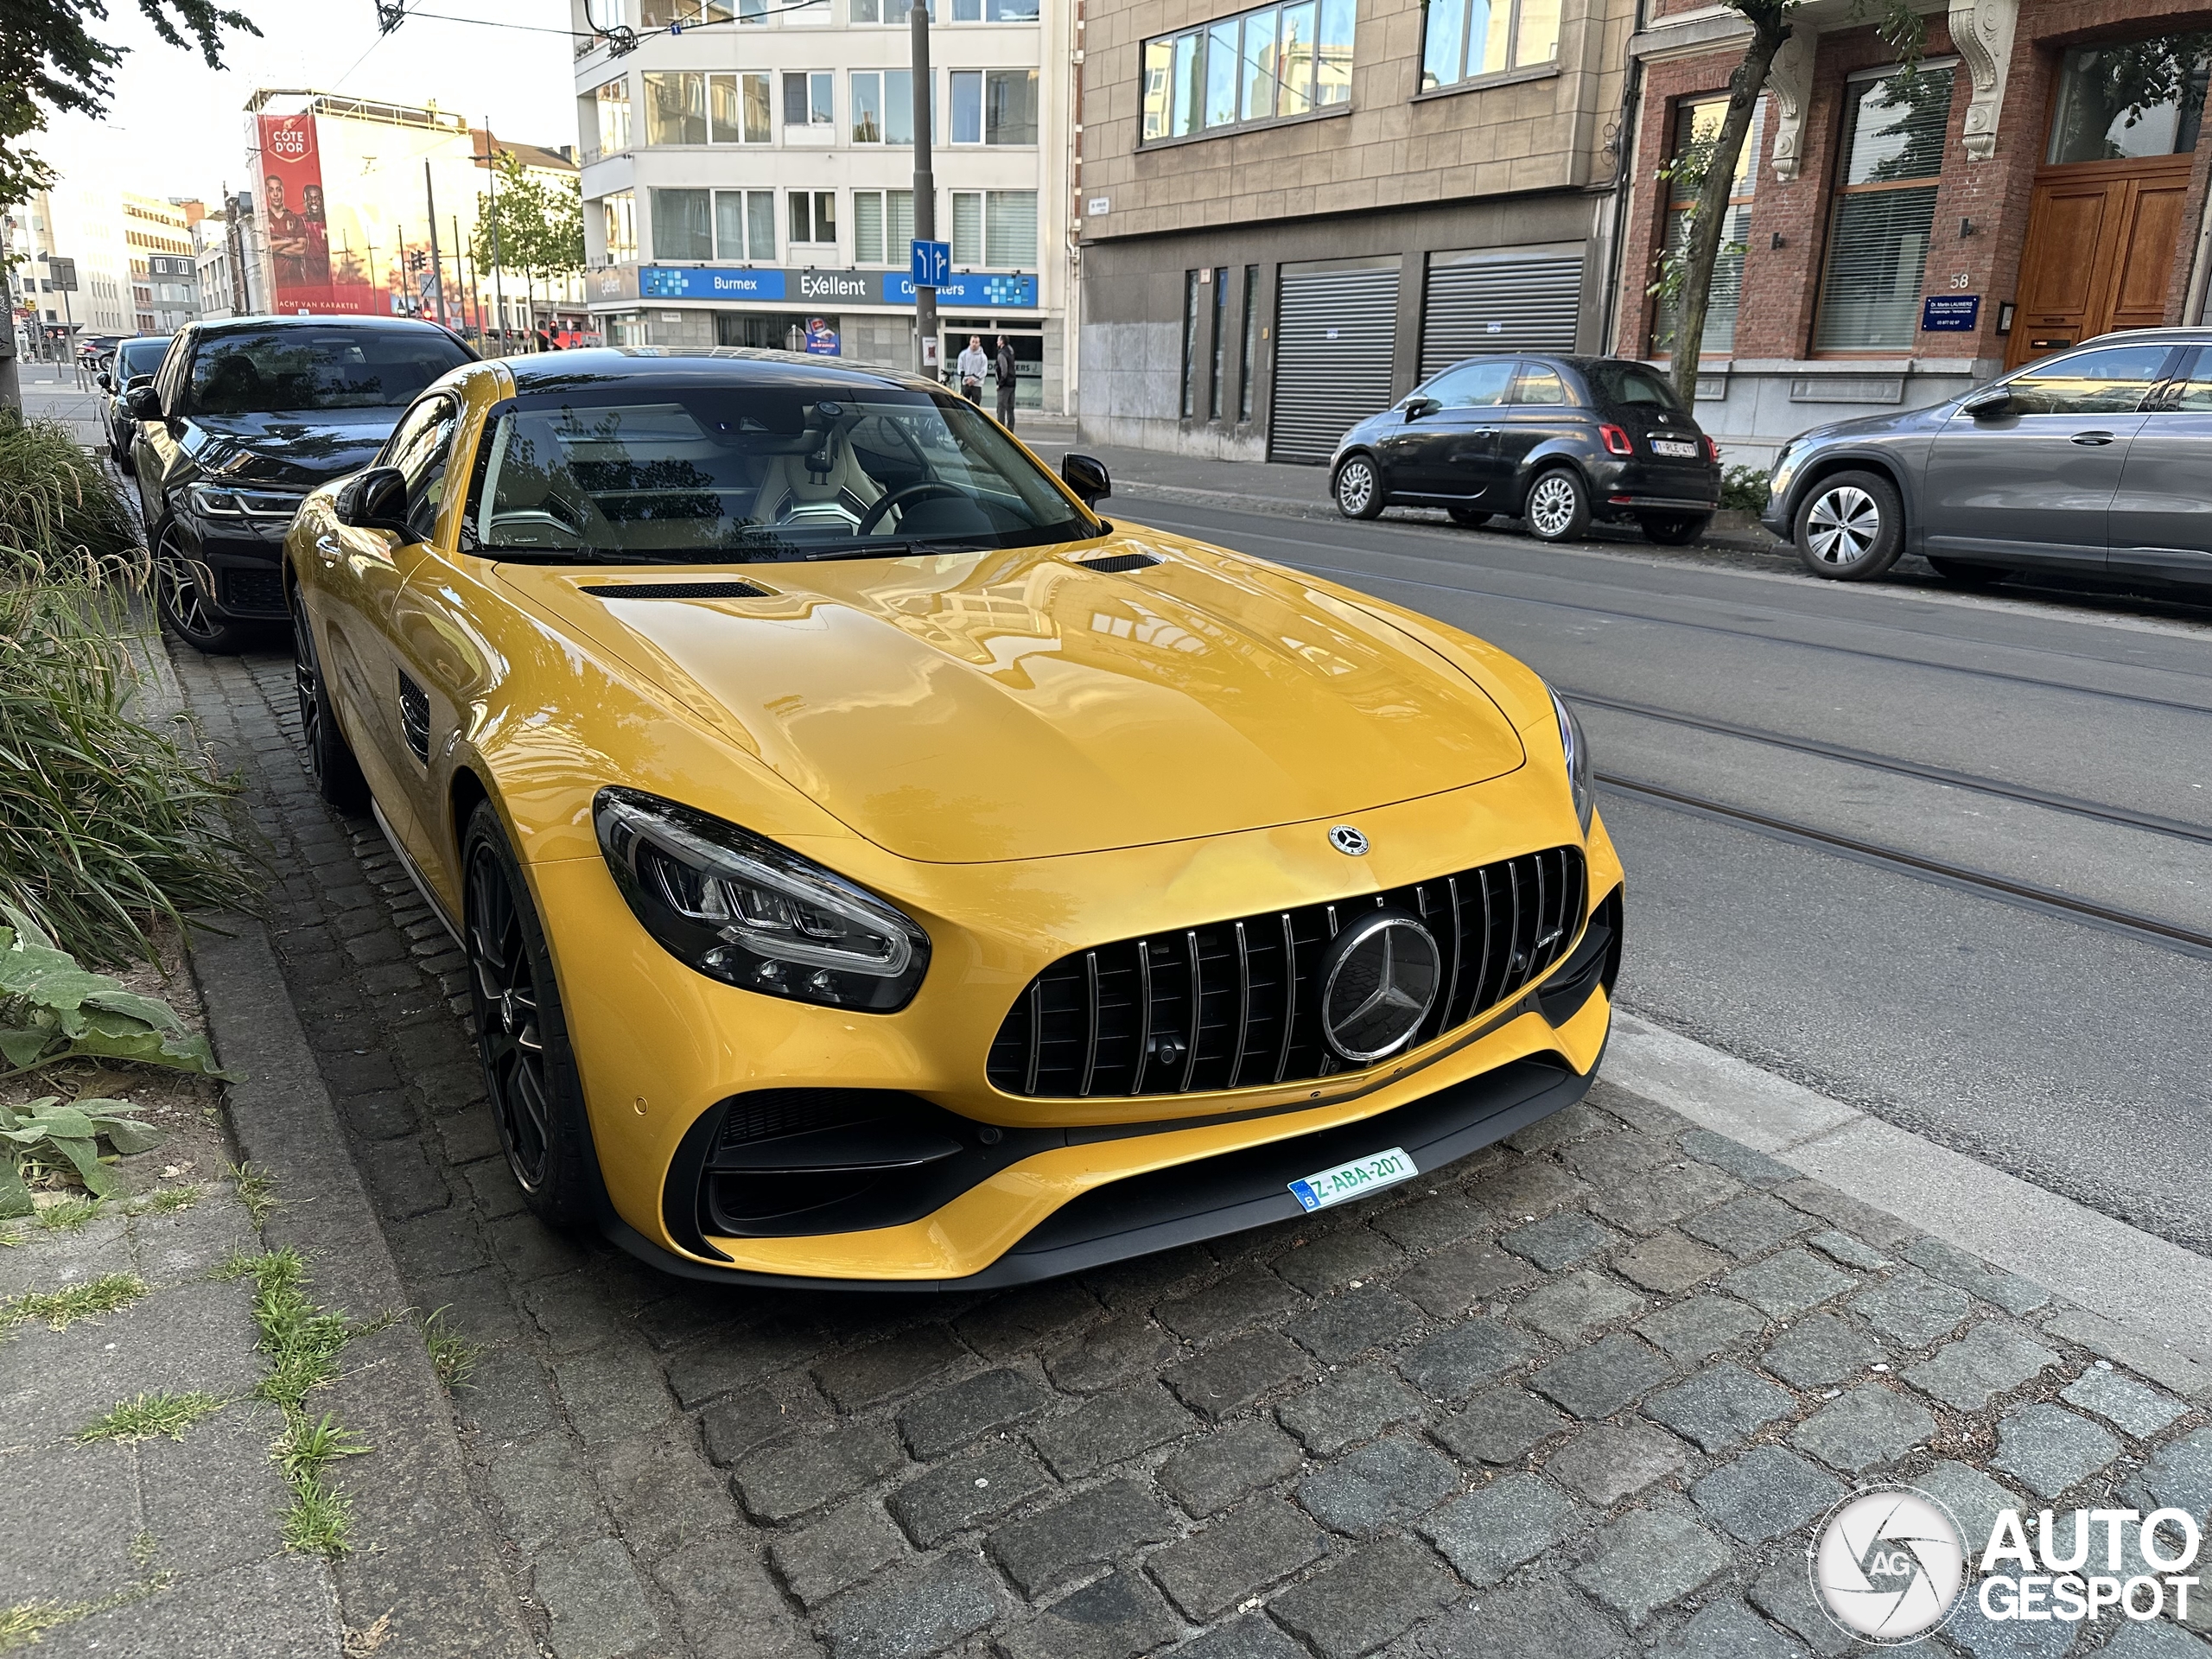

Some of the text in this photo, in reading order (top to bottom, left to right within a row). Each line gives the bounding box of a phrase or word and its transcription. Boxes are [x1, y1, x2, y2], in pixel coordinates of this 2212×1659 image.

[276, 142, 303, 153] D'OR
[714, 276, 757, 290] Burmex
[800, 275, 866, 298] Exellent
[1950, 273, 1969, 289] 58
[320, 301, 359, 309] KARAKTER
[1309, 1155, 1405, 1199] Z-ABA-201
[1305, 1196, 1315, 1207] B
